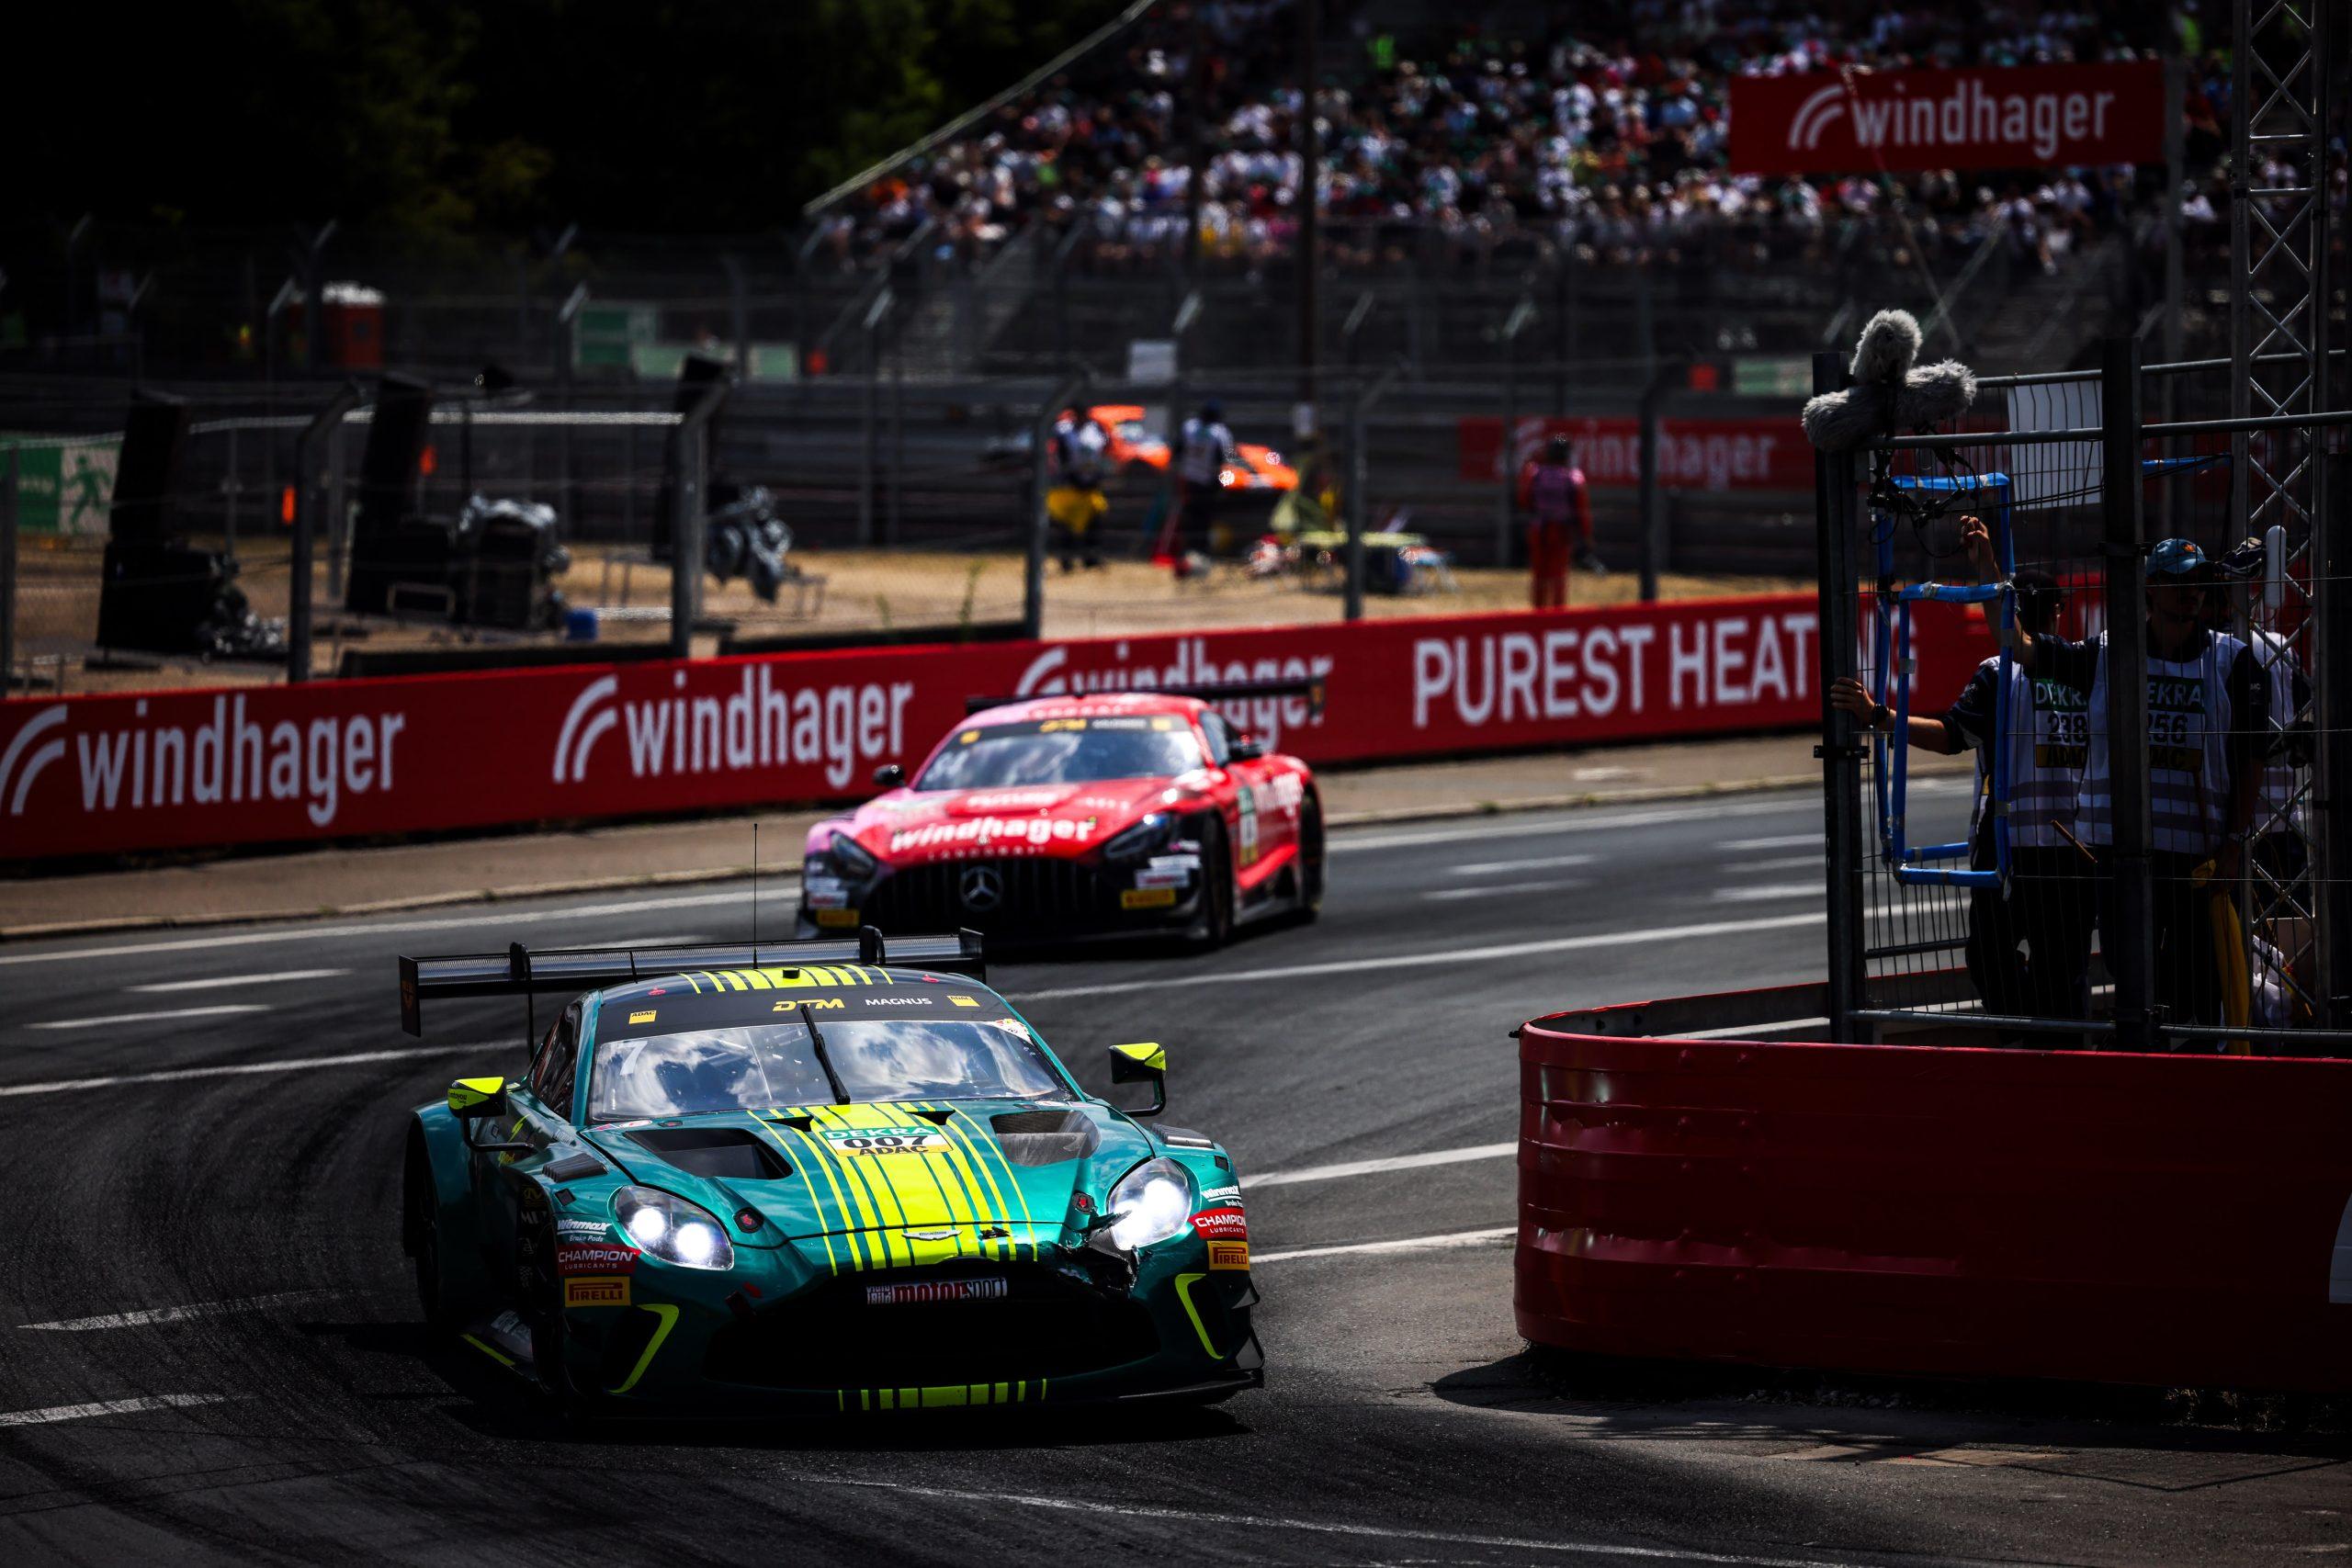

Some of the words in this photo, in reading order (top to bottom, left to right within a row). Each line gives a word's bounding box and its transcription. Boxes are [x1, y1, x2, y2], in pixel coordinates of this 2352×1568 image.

[1850, 80, 2114, 160] windhager
[1412, 626, 1654, 728] PUREST
[1668, 604, 1918, 709] HEATNG
[2146, 681, 2204, 707] EKRA
[625, 663, 913, 789] windhager
[77, 694, 404, 826] windhager
[890, 817, 1097, 852] windhager
[773, 998, 845, 1012] DTM
[865, 997, 933, 1007] MAGNUS
[826, 1126, 937, 1140] DEKRA
[843, 1135, 929, 1148] 007
[858, 1145, 929, 1156] ADAC
[1195, 1214, 1246, 1227] CHAMPION
[559, 1249, 634, 1263] CHAMPION
[1213, 1247, 1248, 1265] PIRELLI
[569, 1282, 623, 1302] PIRELLI
